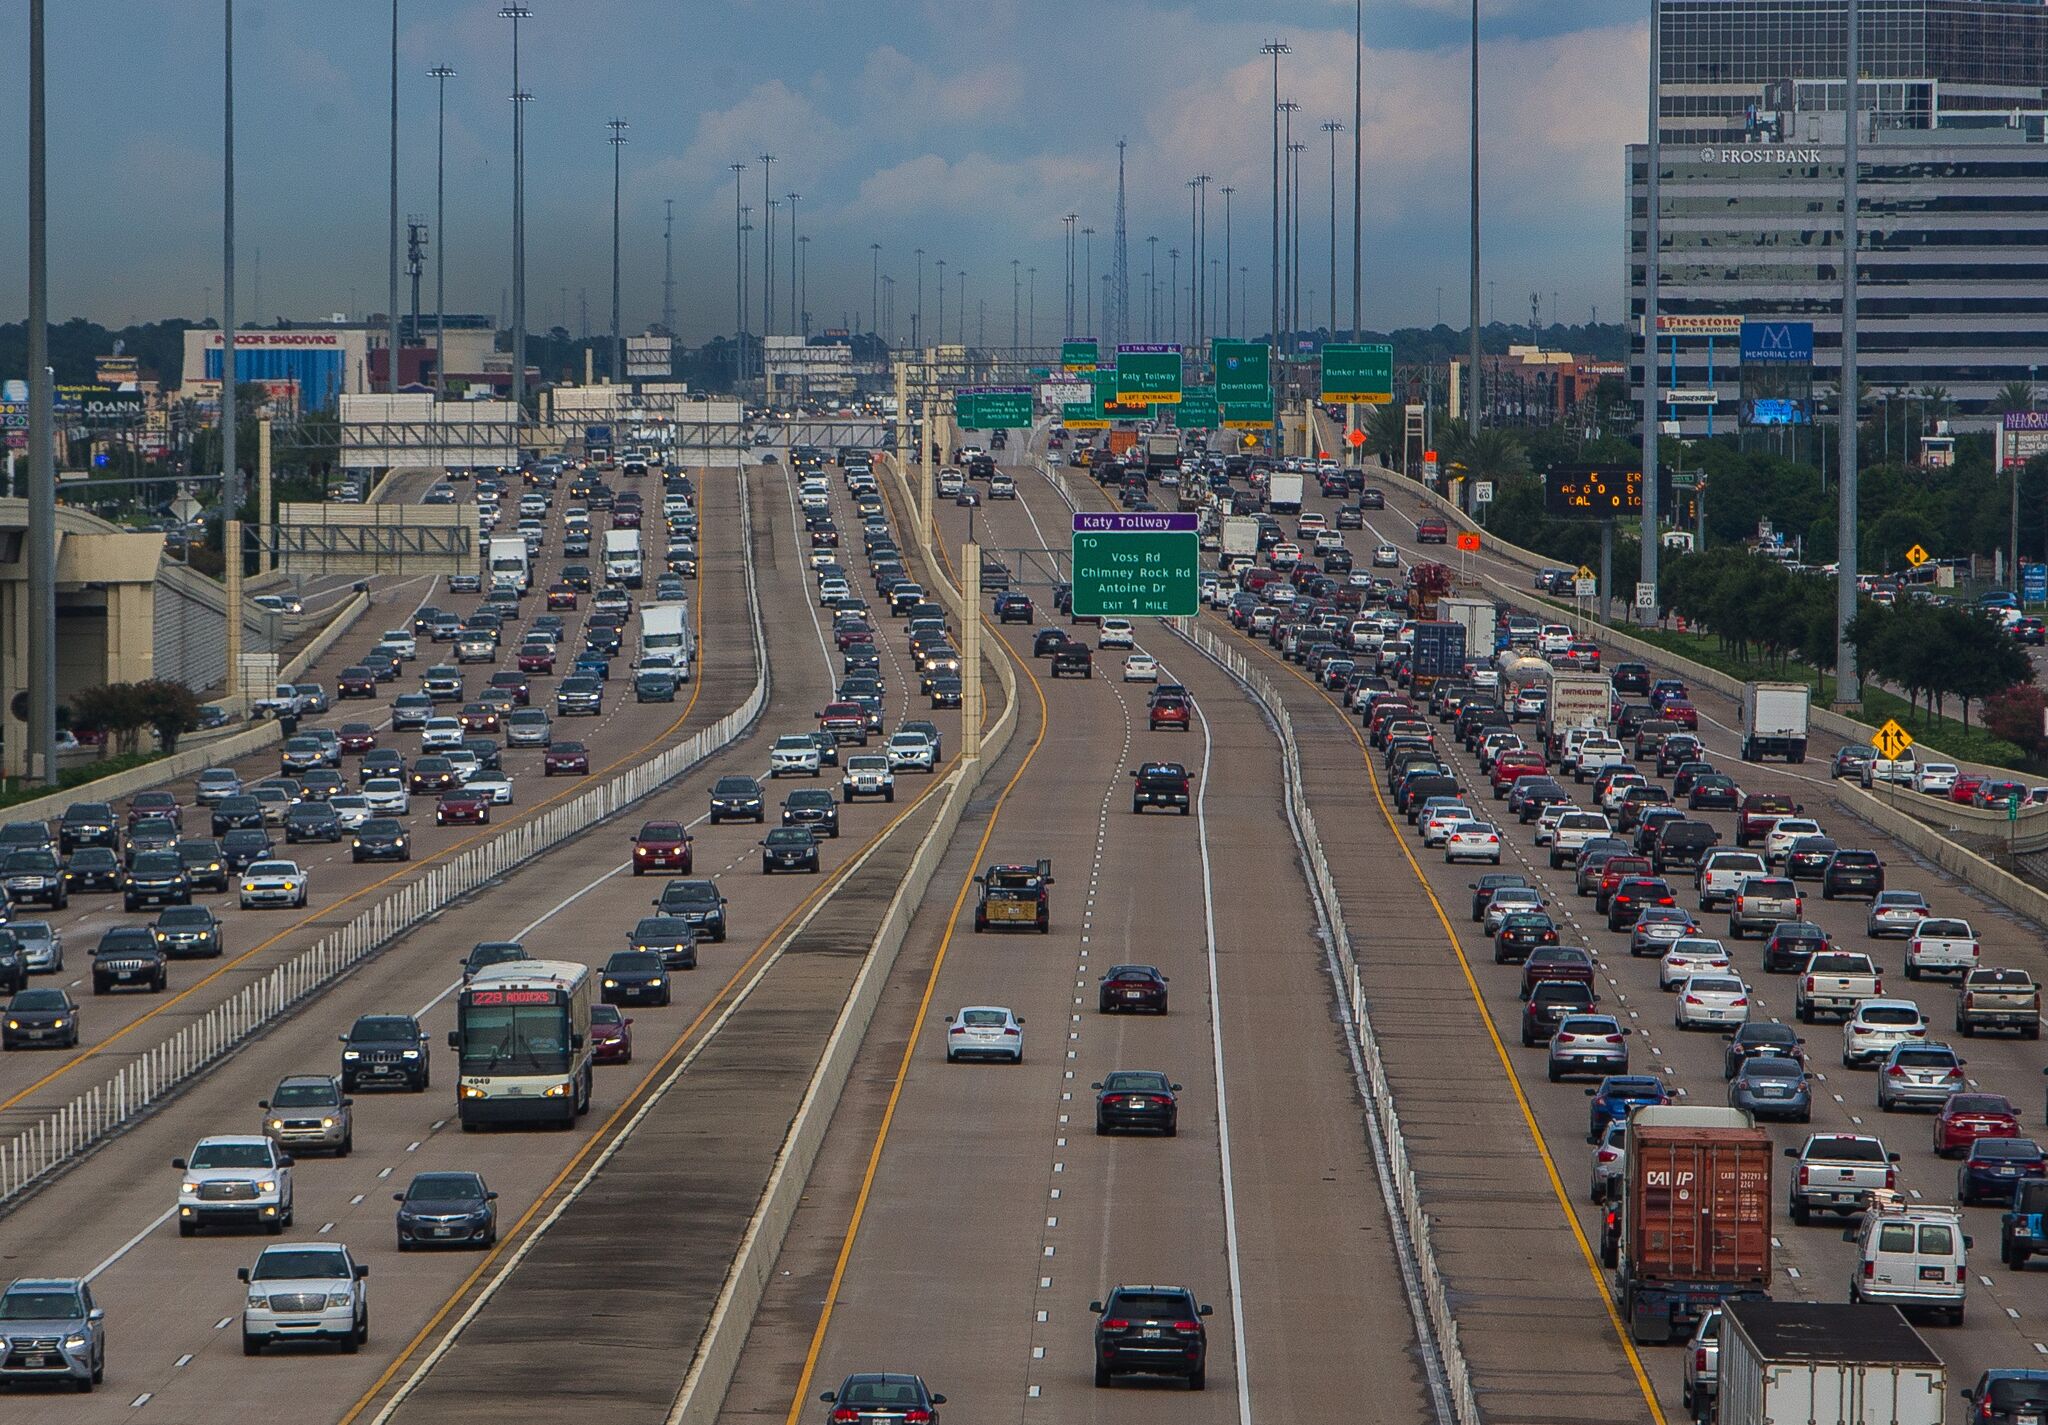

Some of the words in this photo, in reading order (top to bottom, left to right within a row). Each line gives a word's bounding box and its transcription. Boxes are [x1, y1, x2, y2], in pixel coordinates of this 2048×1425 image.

[1722, 150, 1773, 163] FROST
[1777, 150, 1821, 163] BANK
[1667, 316, 1741, 327] Firestone
[269, 335, 337, 345] SKYDIVING
[1745, 350, 1788, 358] MEMORIAL
[1789, 350, 1808, 358] CITY
[1326, 368, 1355, 376] Bunker
[1359, 368, 1374, 376] Hill
[1376, 368, 1388, 376] Rd
[1122, 373, 1140, 382] Katy
[1145, 373, 1176, 382] Tollway
[1083, 517, 1112, 530] Katy
[1118, 517, 1171, 530] Tollway
[1082, 538, 1098, 548] TO
[1111, 552, 1139, 562] Voss
[1145, 552, 1161, 562] Rd
[1081, 567, 1134, 580] Chimney
[1140, 567, 1169, 578] Rock
[1175, 568, 1191, 578] Rd
[1098, 583, 1146, 593] Antoine
[1152, 583, 1166, 593] Dr
[1102, 601, 1123, 610] EXIT
[1131, 598, 1138, 610] 1
[1145, 601, 1168, 610] MILE
[1639, 597, 1652, 606] 60
[506, 991, 550, 1003] ADDICKS
